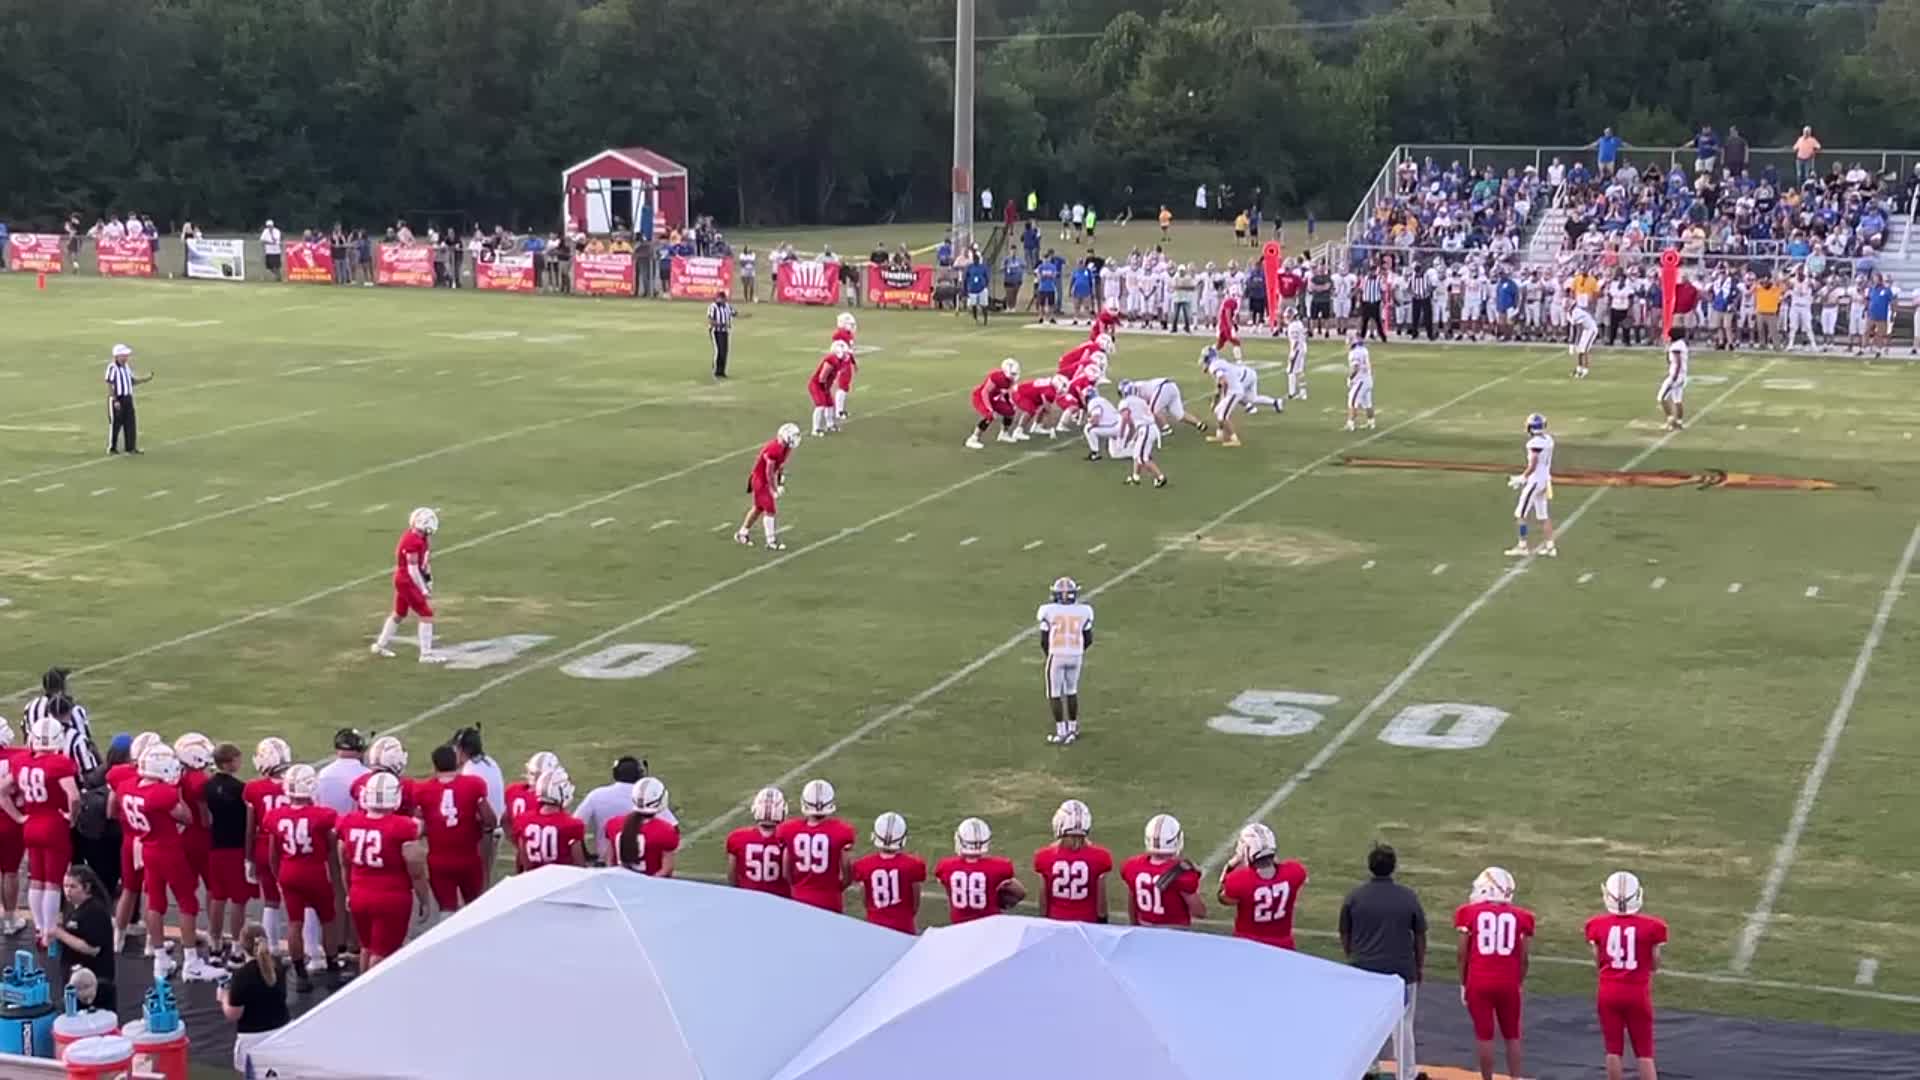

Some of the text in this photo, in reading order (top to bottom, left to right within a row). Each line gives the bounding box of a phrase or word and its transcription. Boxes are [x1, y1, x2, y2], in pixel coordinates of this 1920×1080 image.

[18, 766, 48, 803] 48
[122, 794, 151, 832] 65
[440, 788, 459, 828] 4
[277, 818, 313, 856] 34
[350, 827, 384, 868] 72
[525, 823, 558, 863] 20
[793, 833, 829, 874] 99
[745, 843, 781, 882] 56
[1052, 860, 1089, 900] 22
[871, 869, 902, 909] 81
[950, 870, 986, 909] 88
[1135, 872, 1165, 915] 61
[1253, 881, 1290, 922] 27
[1477, 911, 1517, 956] 80
[1606, 925, 1638, 970] 41
